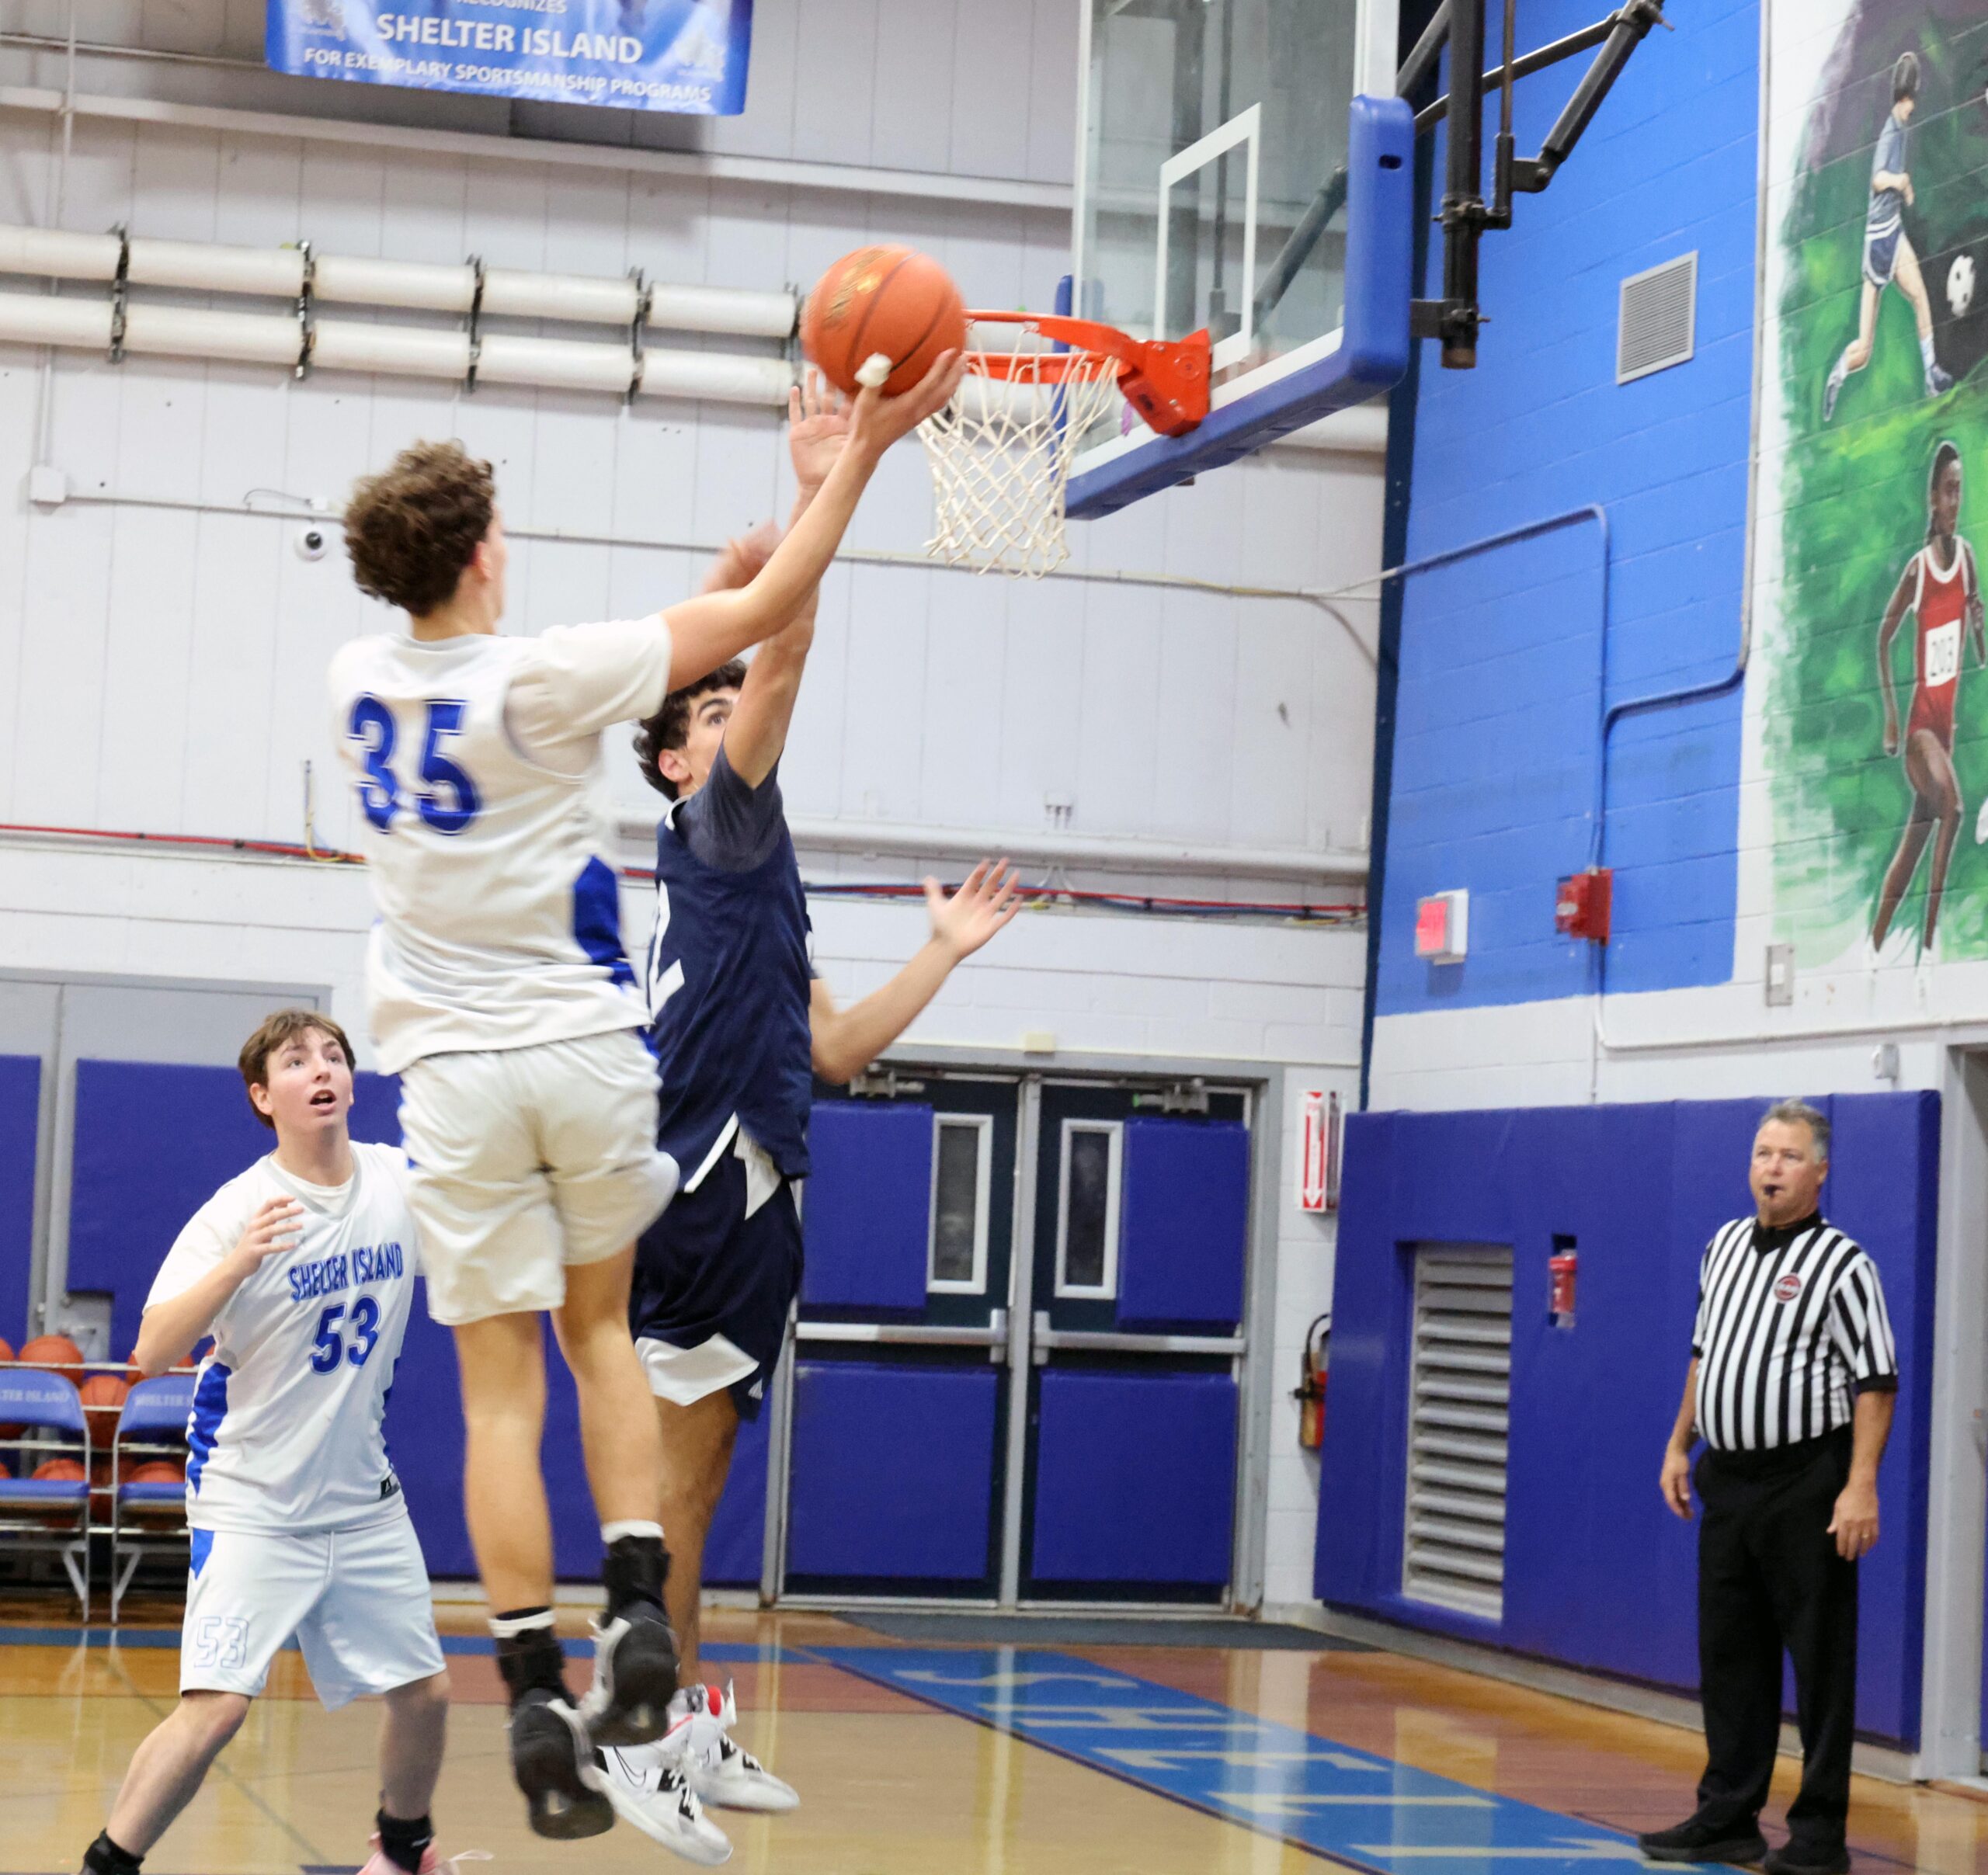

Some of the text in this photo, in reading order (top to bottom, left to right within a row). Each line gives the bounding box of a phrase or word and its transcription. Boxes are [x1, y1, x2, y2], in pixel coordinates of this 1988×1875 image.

[376, 12, 644, 64] SHELTER ISLAND
[303, 47, 712, 103] FOR EXEMPLARY SPORTSMANSHIP PROGRAMS
[346, 691, 481, 835] 35
[287, 1241, 405, 1304] SHELTER ISLAND
[309, 1293, 381, 1376] 53
[194, 1616, 249, 1669] 53
